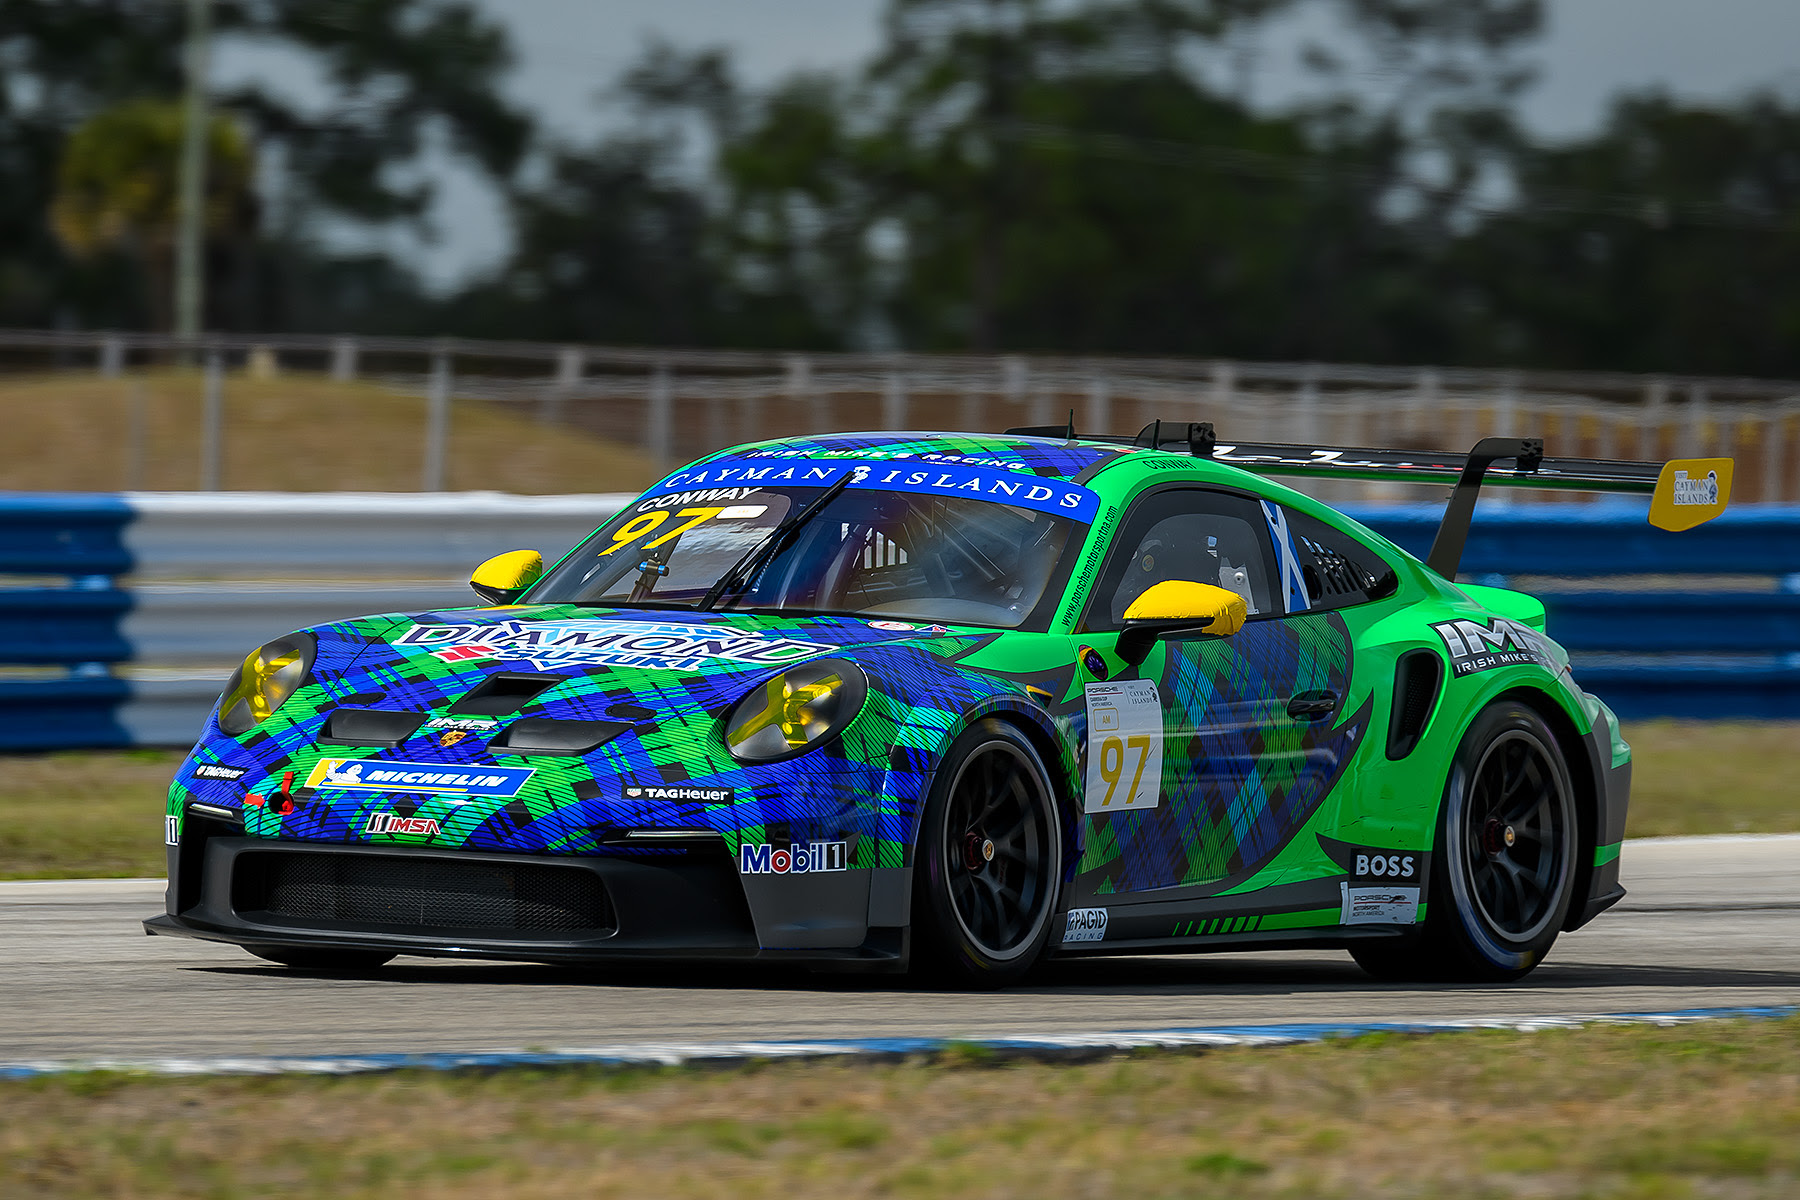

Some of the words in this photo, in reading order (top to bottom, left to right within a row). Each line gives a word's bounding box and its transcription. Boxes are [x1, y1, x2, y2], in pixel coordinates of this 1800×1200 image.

[922, 453, 1026, 469] RACING
[665, 467, 837, 488] CAYMAN
[880, 470, 1082, 508] ISLANDS
[1675, 481, 1709, 491] CAYMAN
[637, 487, 762, 512] CONWAY
[1674, 493, 1708, 503] ISLANDS
[597, 506, 726, 556] 97
[1061, 505, 1118, 627] www.porschemotorsportna.com
[394, 621, 836, 661] DIAMOND
[496, 649, 703, 670] SUZUKI
[1456, 656, 1497, 673] IRISH
[1499, 653, 1539, 663] MIKE'S
[365, 770, 509, 788] MICHELIN
[1100, 734, 1150, 806] 97
[1355, 854, 1415, 877] BOSS
[1075, 910, 1106, 930] PAGID
